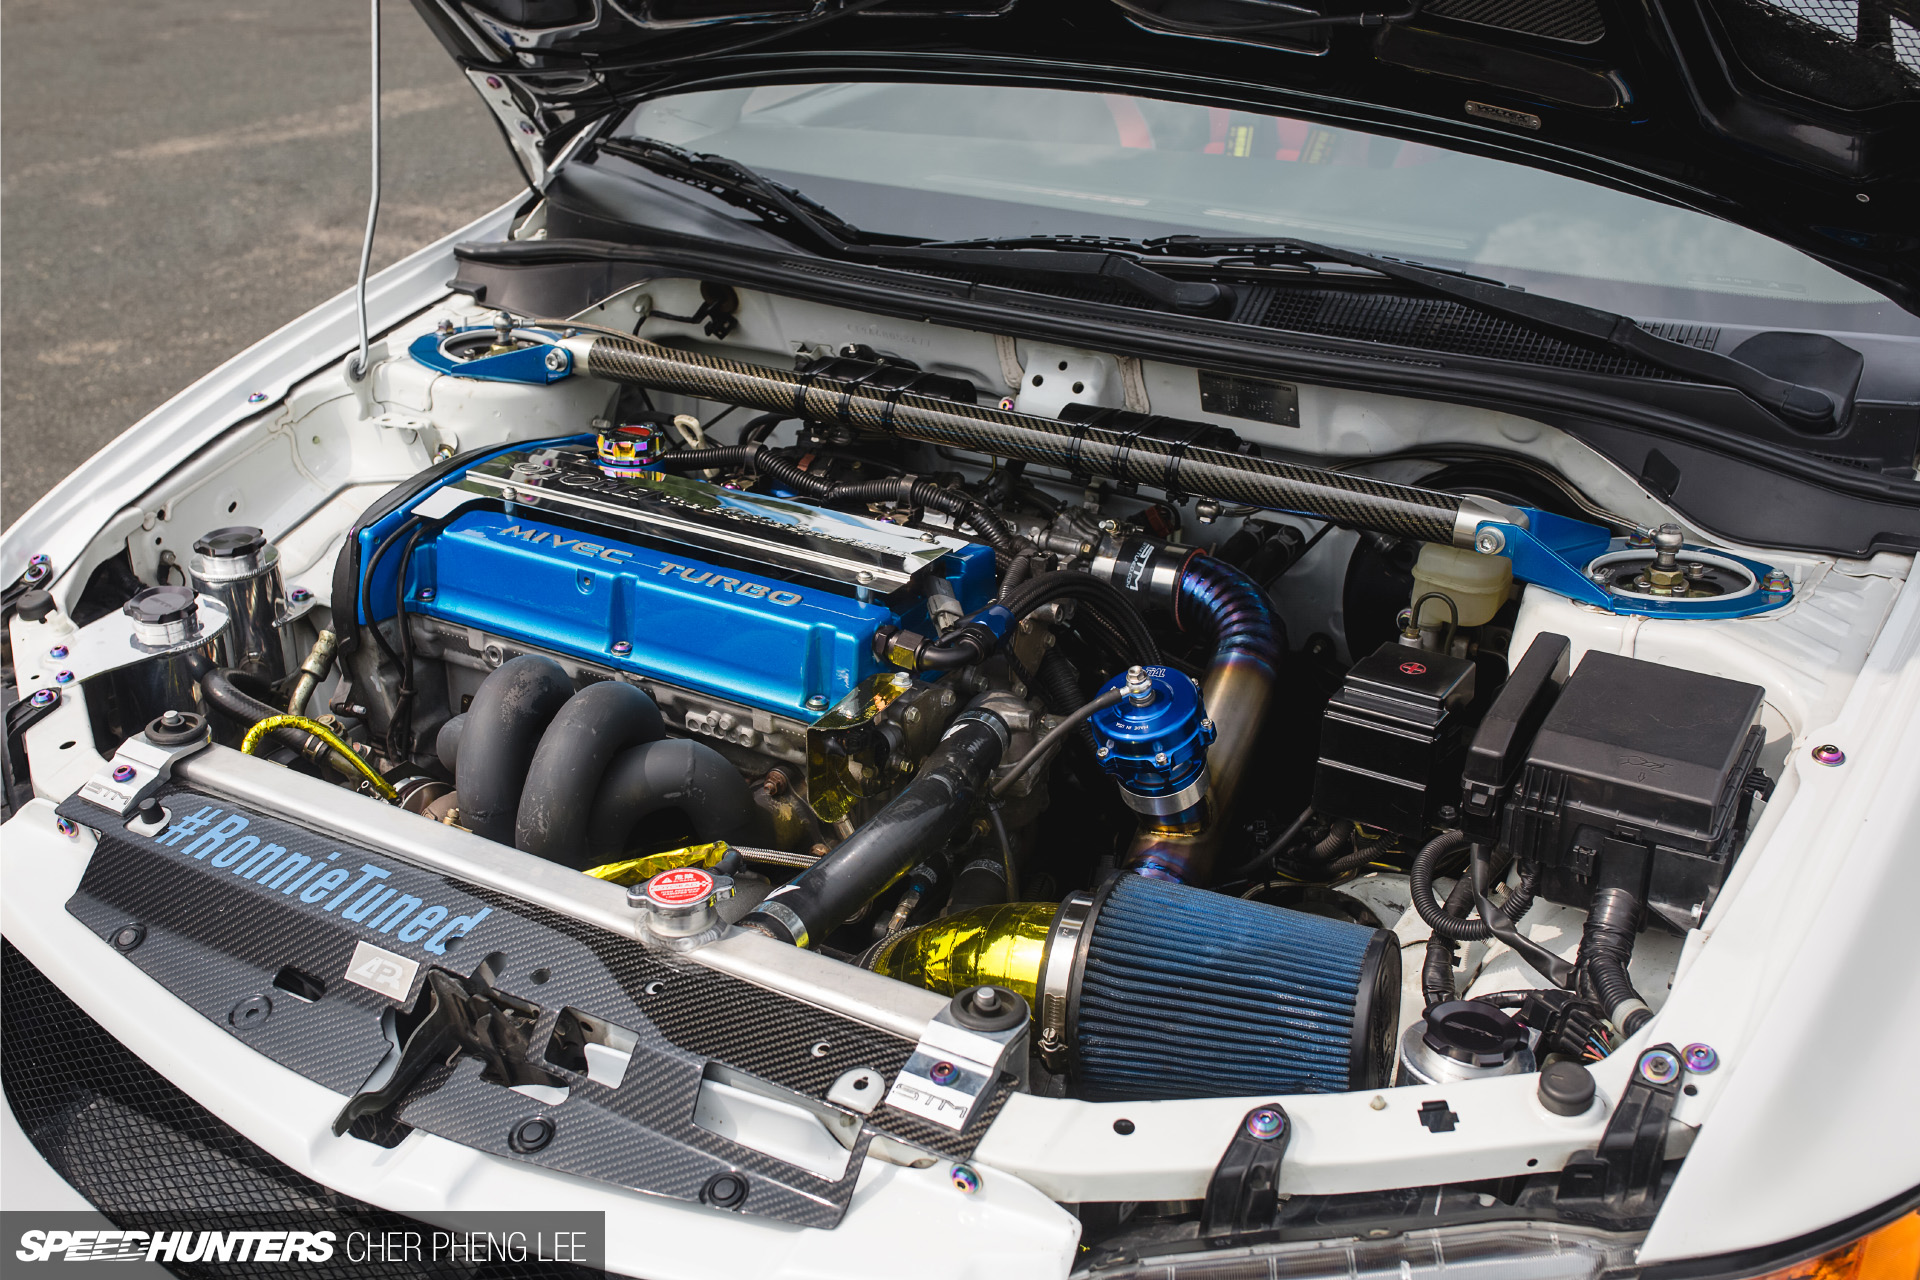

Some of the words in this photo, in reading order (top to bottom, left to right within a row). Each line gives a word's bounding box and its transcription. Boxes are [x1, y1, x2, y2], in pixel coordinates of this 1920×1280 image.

[498, 524, 633, 565] MIVEC
[658, 560, 803, 607] TURBO
[1129, 543, 1155, 591] STM
[84, 781, 132, 806] STM
[154, 805, 493, 956] #RonnieTuned
[892, 1083, 969, 1119] STM
